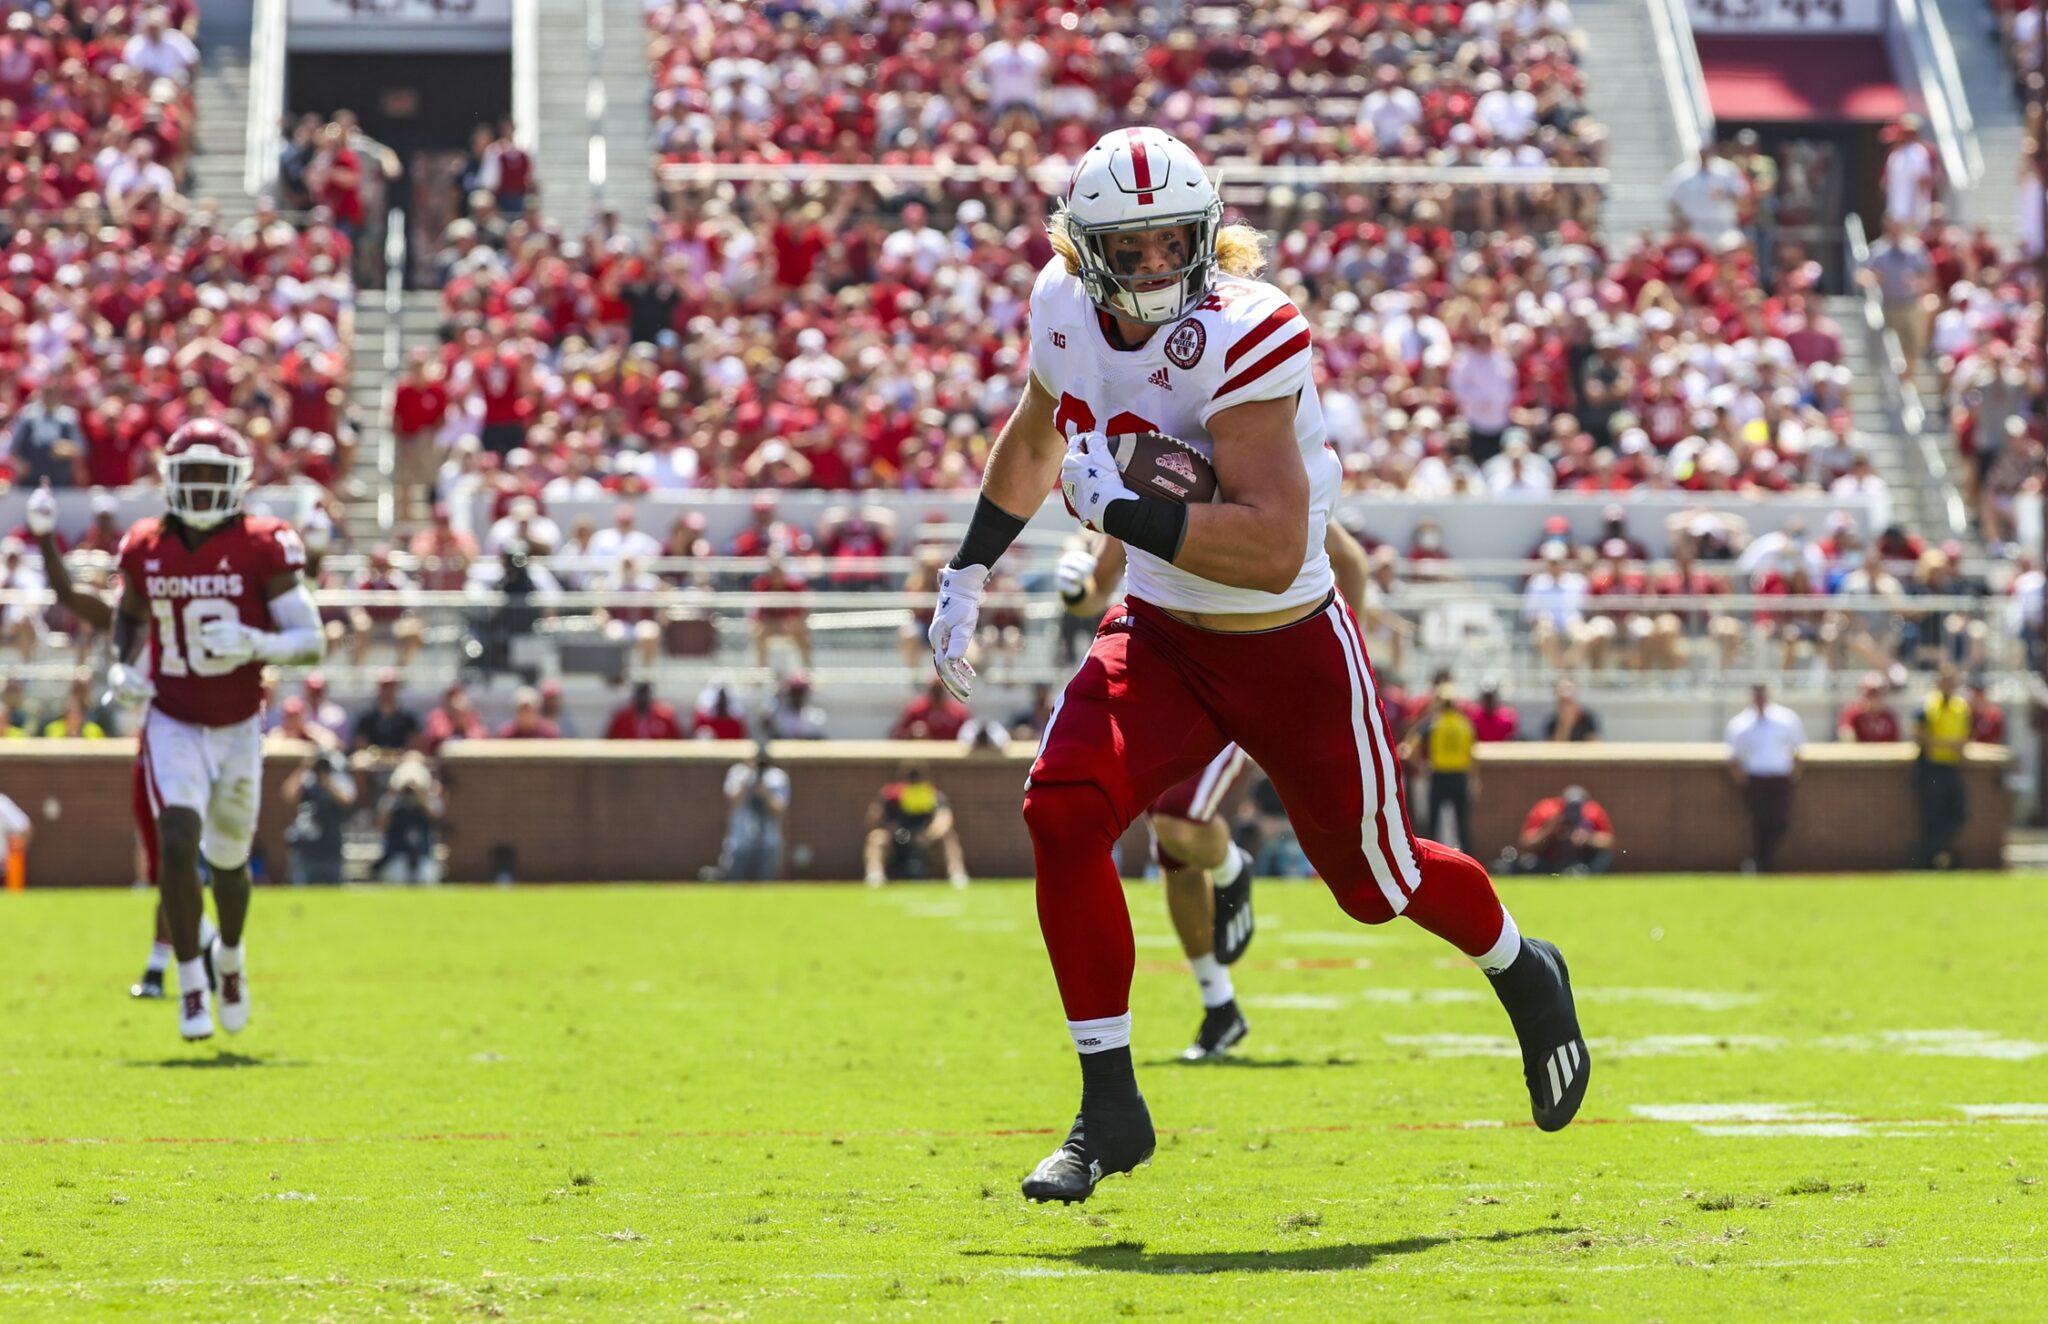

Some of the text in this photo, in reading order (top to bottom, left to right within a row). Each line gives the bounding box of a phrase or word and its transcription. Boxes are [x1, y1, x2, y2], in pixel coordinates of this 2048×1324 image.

[1172, 338, 1196, 349] HUSKERS
[1148, 377, 1172, 391] adidas
[1155, 457, 1197, 484] adidas
[146, 574, 243, 597] SOONERS
